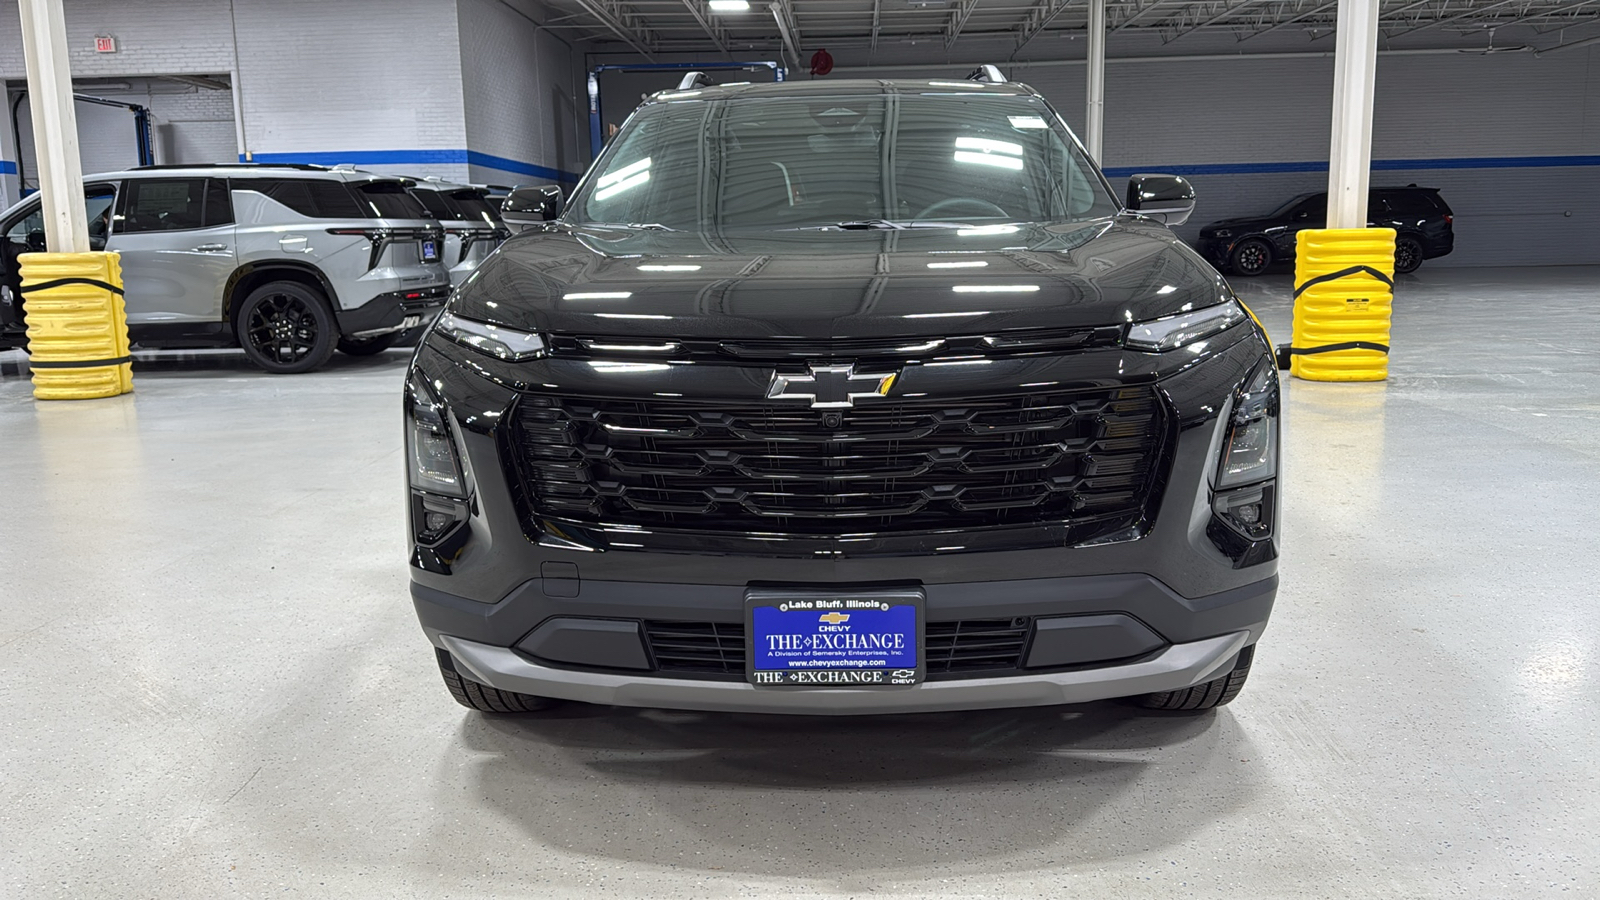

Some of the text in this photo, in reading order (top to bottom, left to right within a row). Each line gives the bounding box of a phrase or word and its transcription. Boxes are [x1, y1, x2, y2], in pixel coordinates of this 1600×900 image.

[97, 38, 112, 51] EXIT
[788, 600, 813, 609] Lake
[846, 600, 880, 608] Illinois
[766, 633, 904, 650] THE EXCHANGE
[788, 658, 886, 668] www.chevyexchange.com
[753, 671, 783, 683] THE
[797, 671, 882, 683] EXCHANGE
